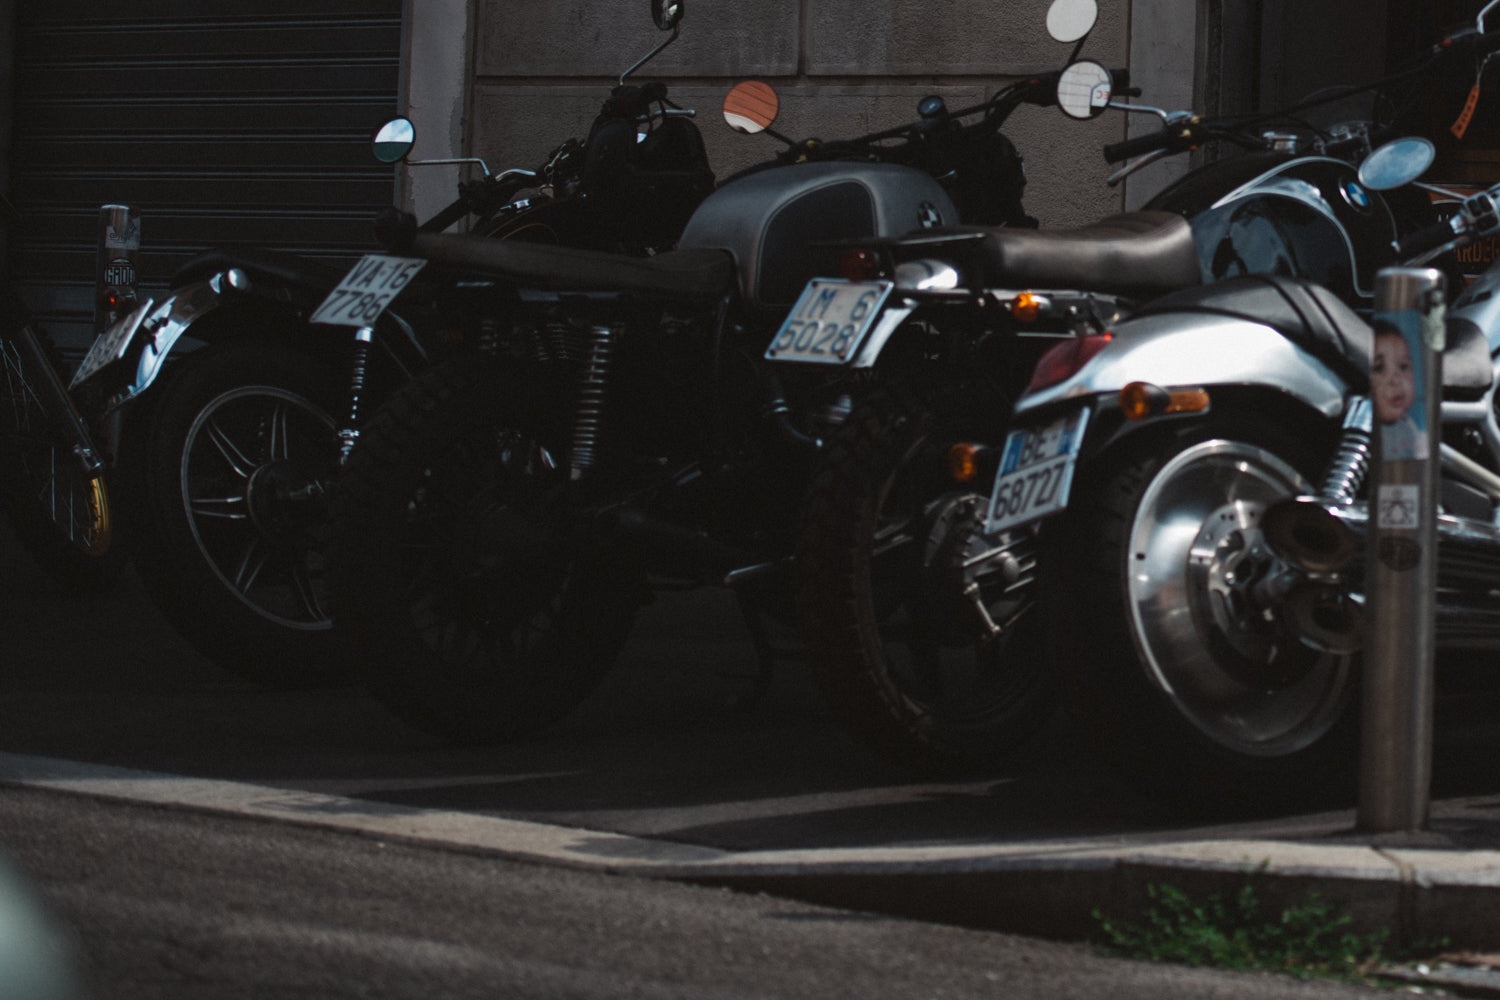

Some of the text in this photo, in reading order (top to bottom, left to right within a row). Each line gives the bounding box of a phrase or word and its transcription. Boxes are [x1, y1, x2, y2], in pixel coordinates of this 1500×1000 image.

[346, 259, 417, 290] VA 16
[311, 290, 389, 321] 7786
[850, 290, 877, 321] 6
[776, 320, 855, 354] 5028
[993, 463, 1066, 520] 68727
